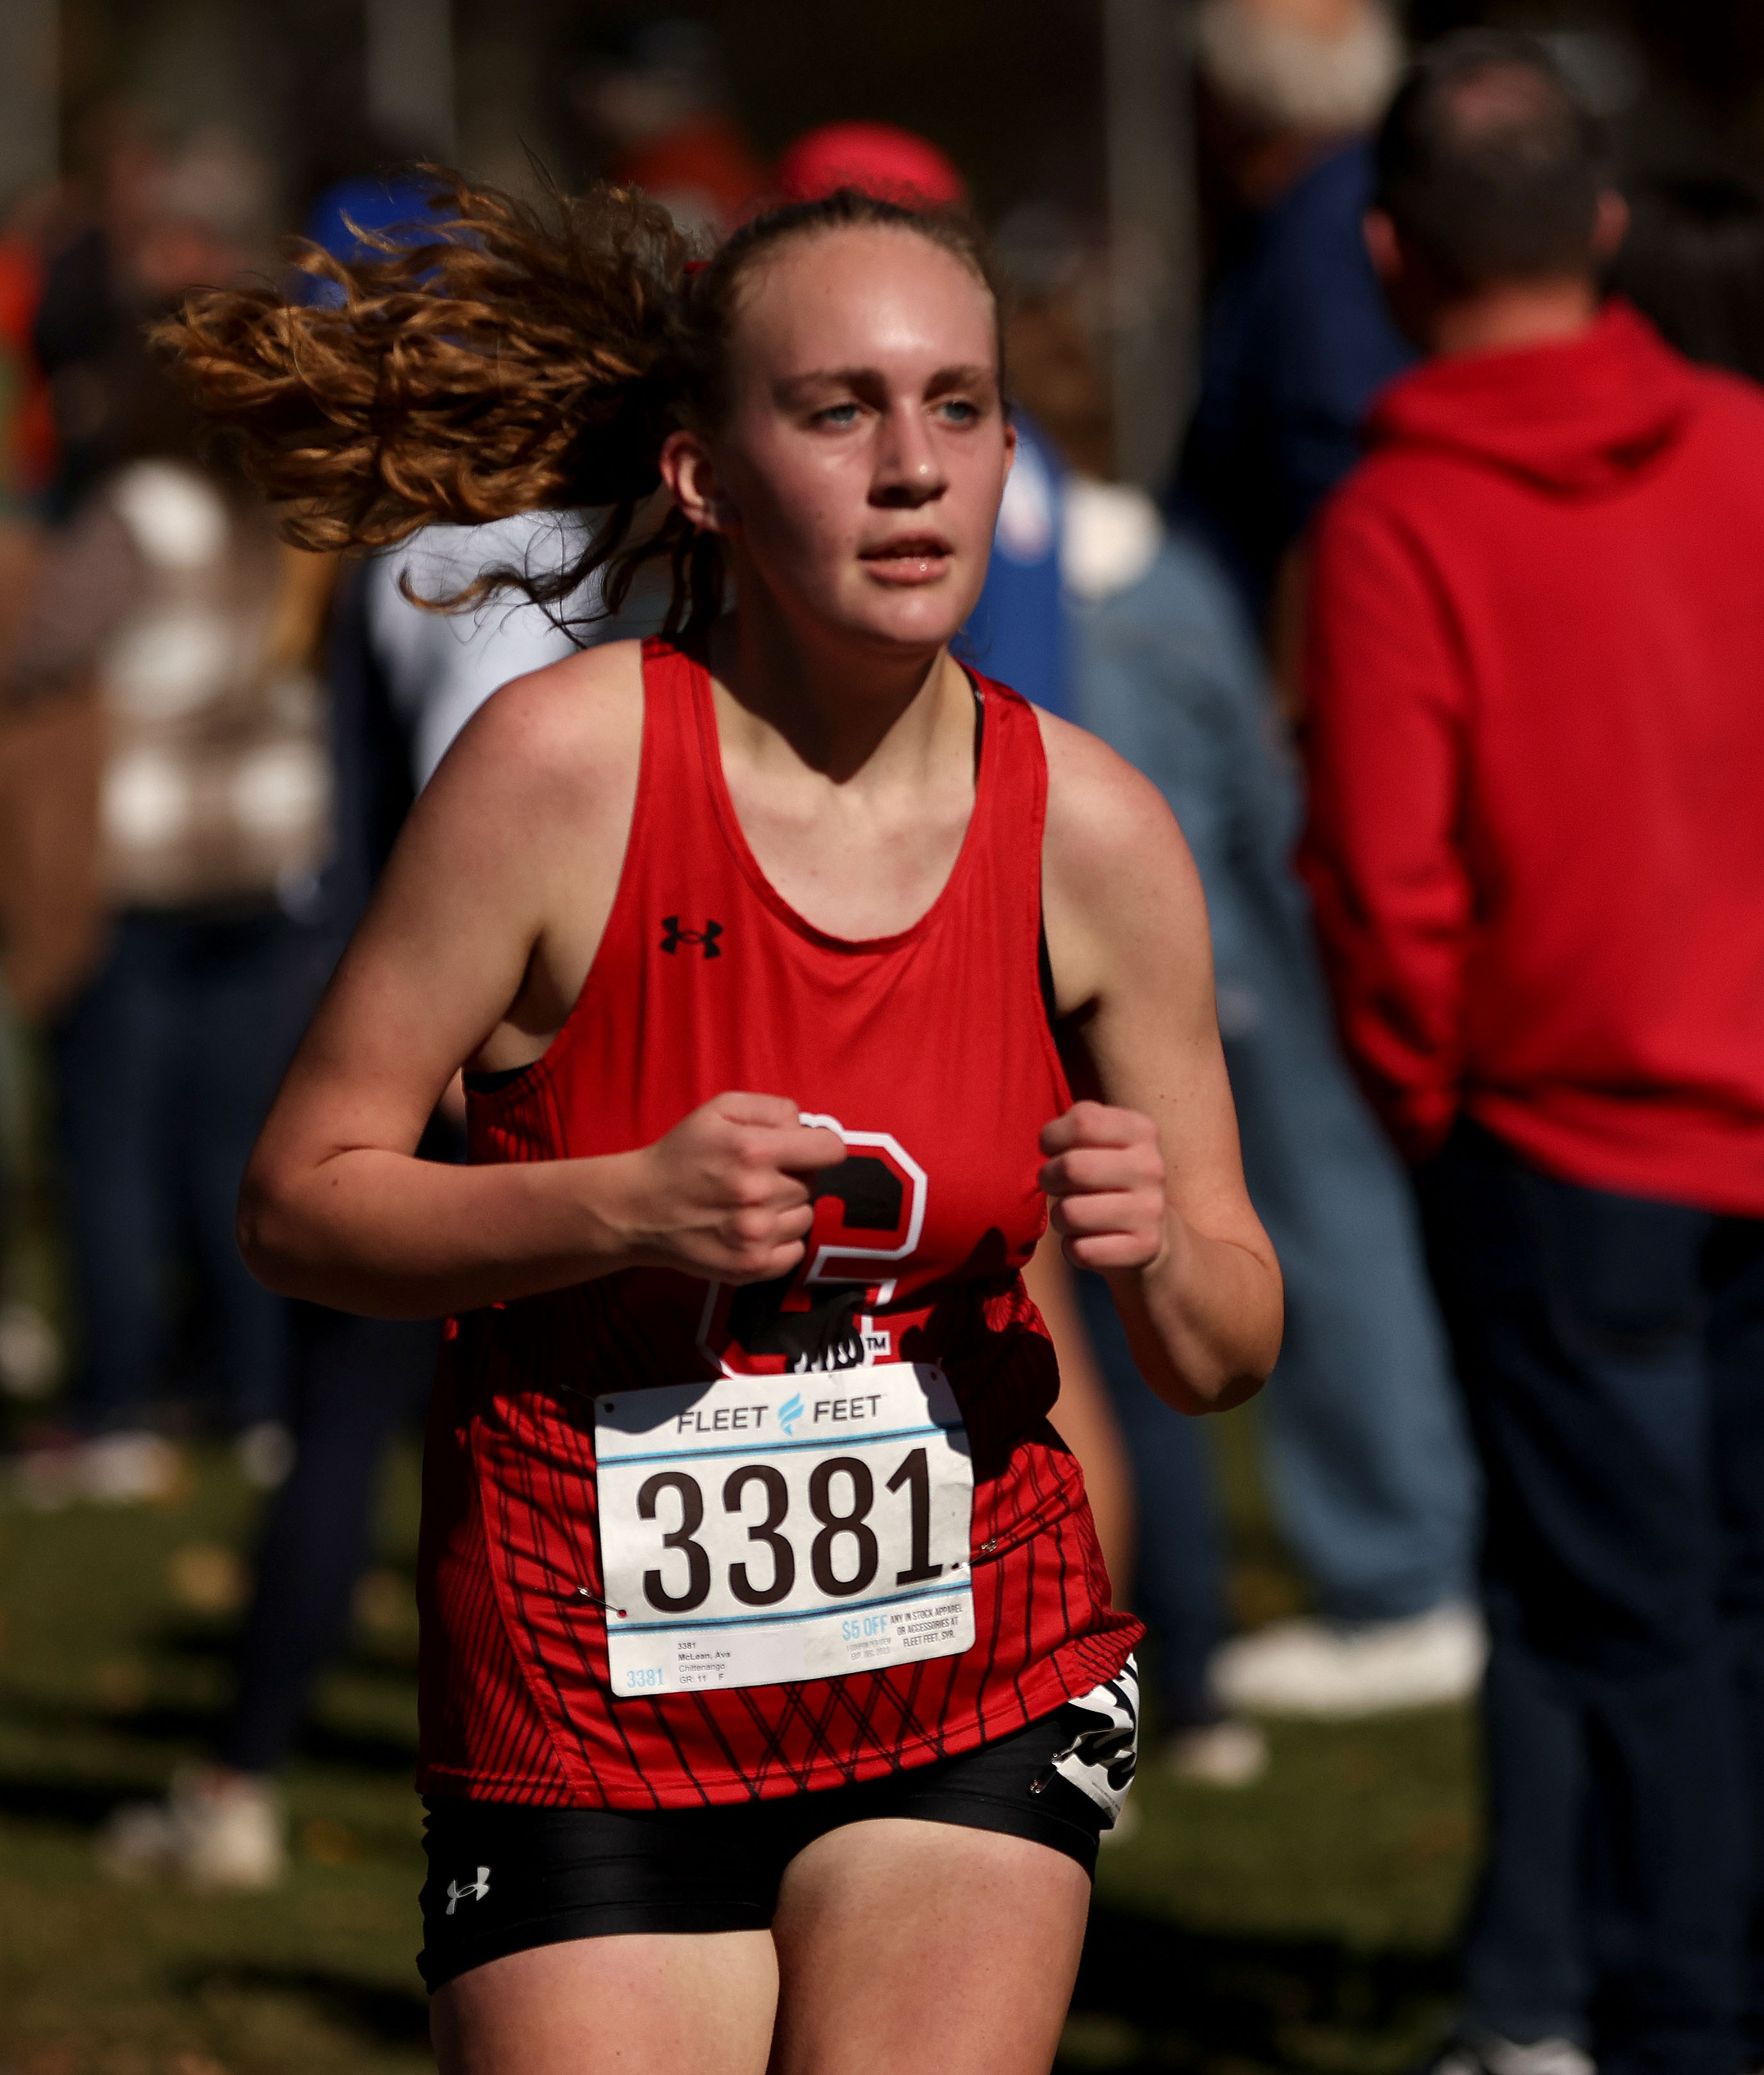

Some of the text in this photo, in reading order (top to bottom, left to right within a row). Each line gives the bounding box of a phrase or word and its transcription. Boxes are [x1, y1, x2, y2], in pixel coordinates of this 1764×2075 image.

[866, 1337, 887, 1348] TM
[677, 1394, 881, 1434] FLEET FEET
[636, 1448, 943, 1614] 3381
[891, 1604, 963, 1624] ANY IN STOCK APPAREL
[842, 1614, 887, 1641] $5 OFF
[897, 1617, 959, 1635] OR ACCESSORIES AT
[903, 1635, 922, 1647] FLEET
[678, 1653, 713, 1662] McLean,
[679, 1663, 725, 1673] Chittenango
[627, 1668, 664, 1688] 3381
[679, 1676, 695, 1684] GR:
